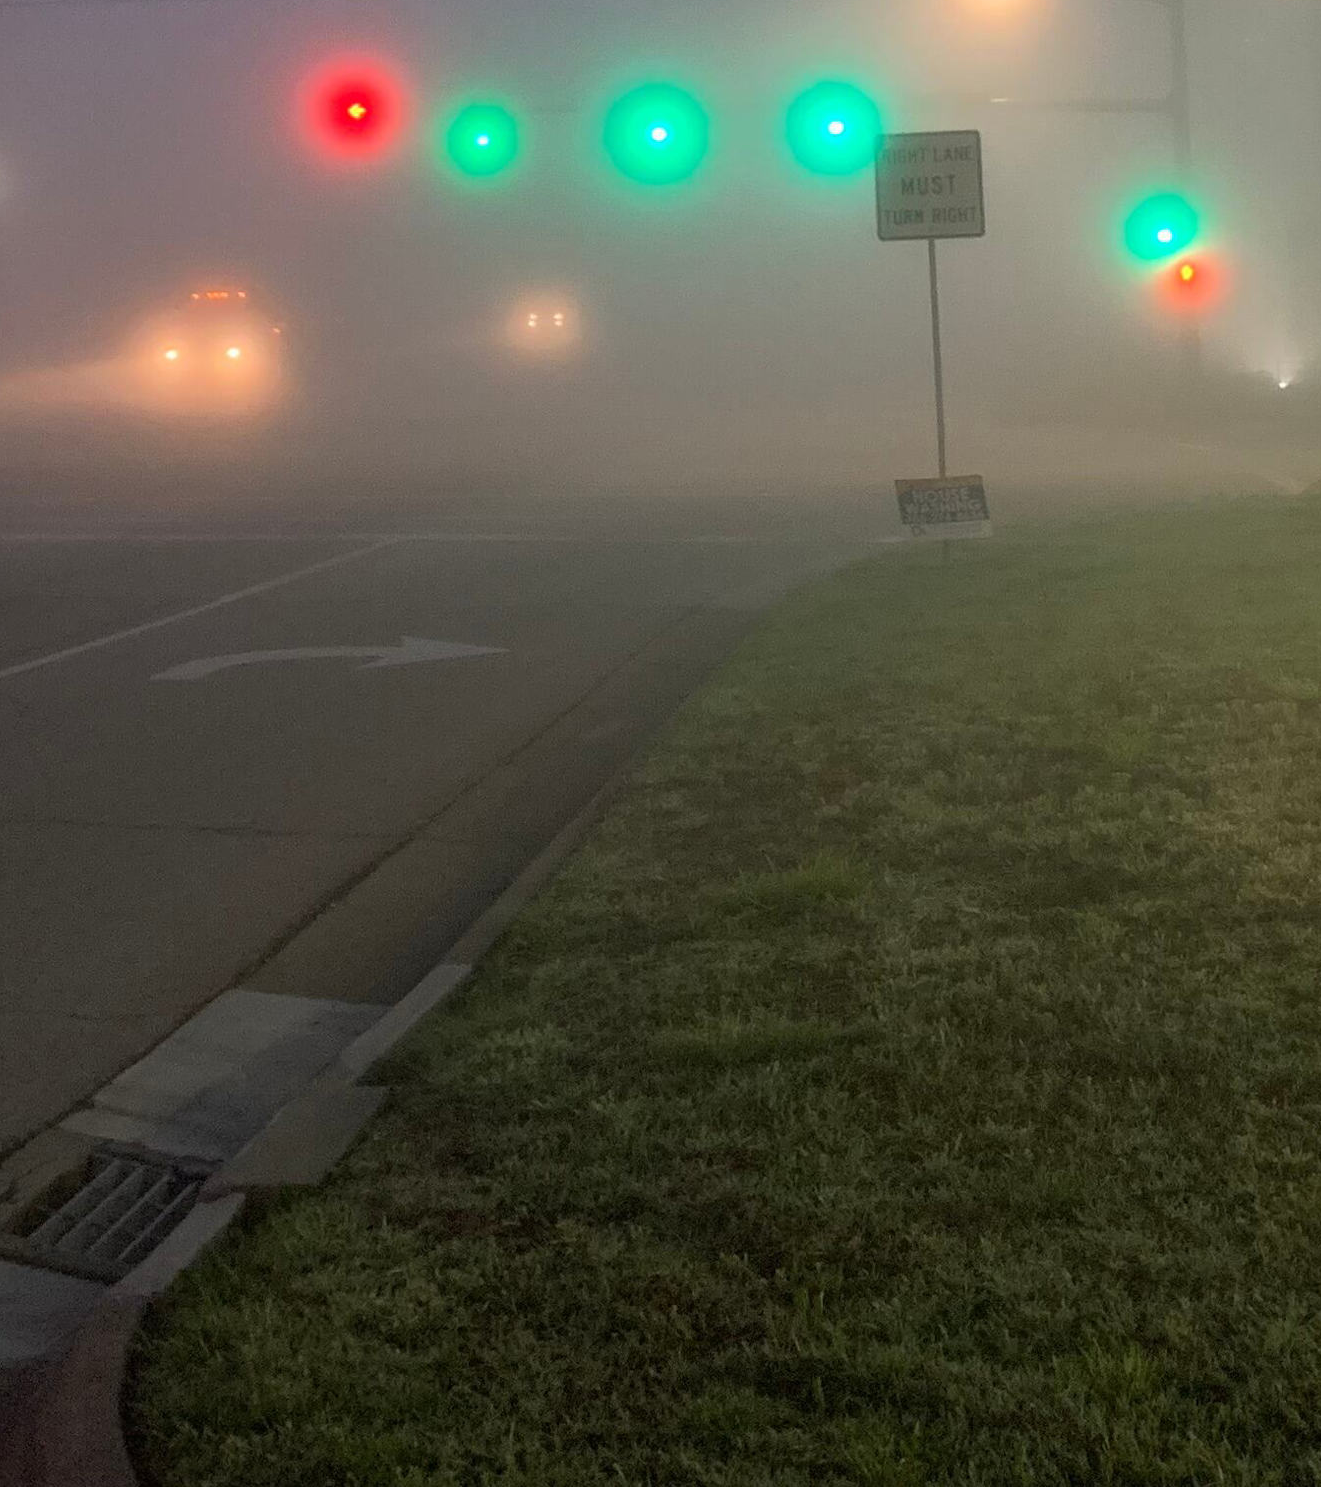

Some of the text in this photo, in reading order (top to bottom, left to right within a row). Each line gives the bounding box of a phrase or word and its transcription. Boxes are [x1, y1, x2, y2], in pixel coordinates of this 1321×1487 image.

[882, 145, 973, 164] RIGHT LANE
[900, 174, 955, 195] MUST
[885, 206, 976, 225] TURN RIGHT
[912, 486, 969, 504] HOUSE
